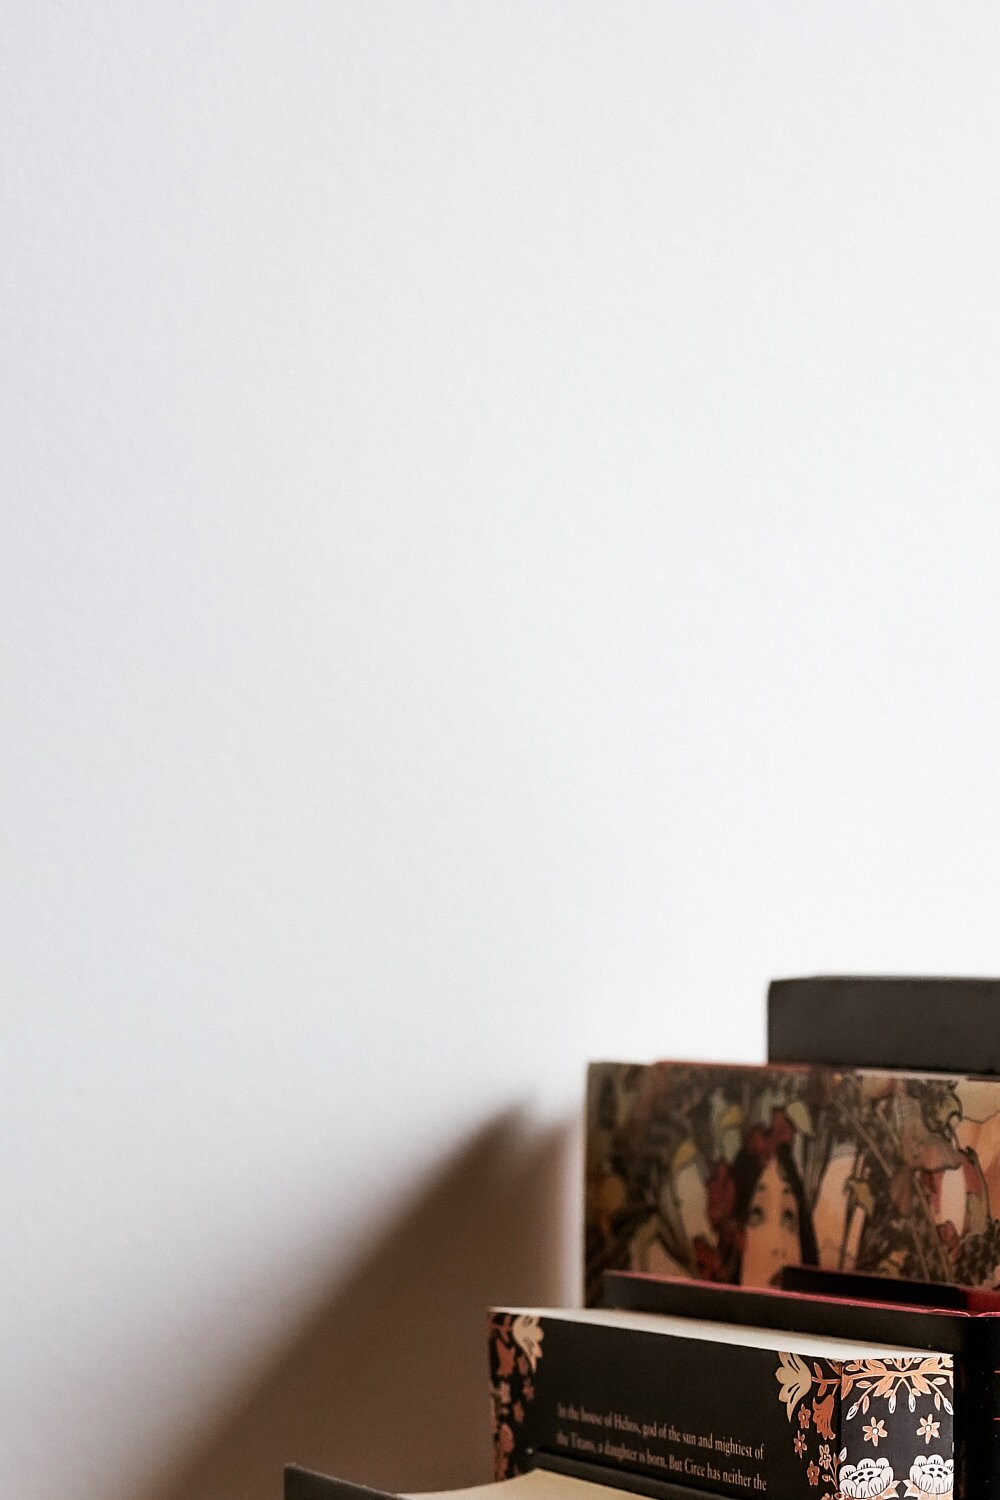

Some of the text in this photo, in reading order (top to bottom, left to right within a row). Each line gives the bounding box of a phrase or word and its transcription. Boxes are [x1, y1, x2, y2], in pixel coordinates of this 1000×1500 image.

[642, 1421, 657, 1439] god
[658, 1423, 667, 1440] of
[668, 1425, 681, 1443] the
[682, 1431, 697, 1445] sun
[698, 1432, 713, 1449] and
[715, 1436, 753, 1459] mightiest
[754, 1443, 765, 1460] of
[646, 1448, 667, 1469] born.
[669, 1454, 683, 1472] But
[684, 1457, 705, 1478] Circe
[706, 1461, 721, 1481] has
[722, 1468, 751, 1487] neither
[753, 1473, 767, 1491] the
